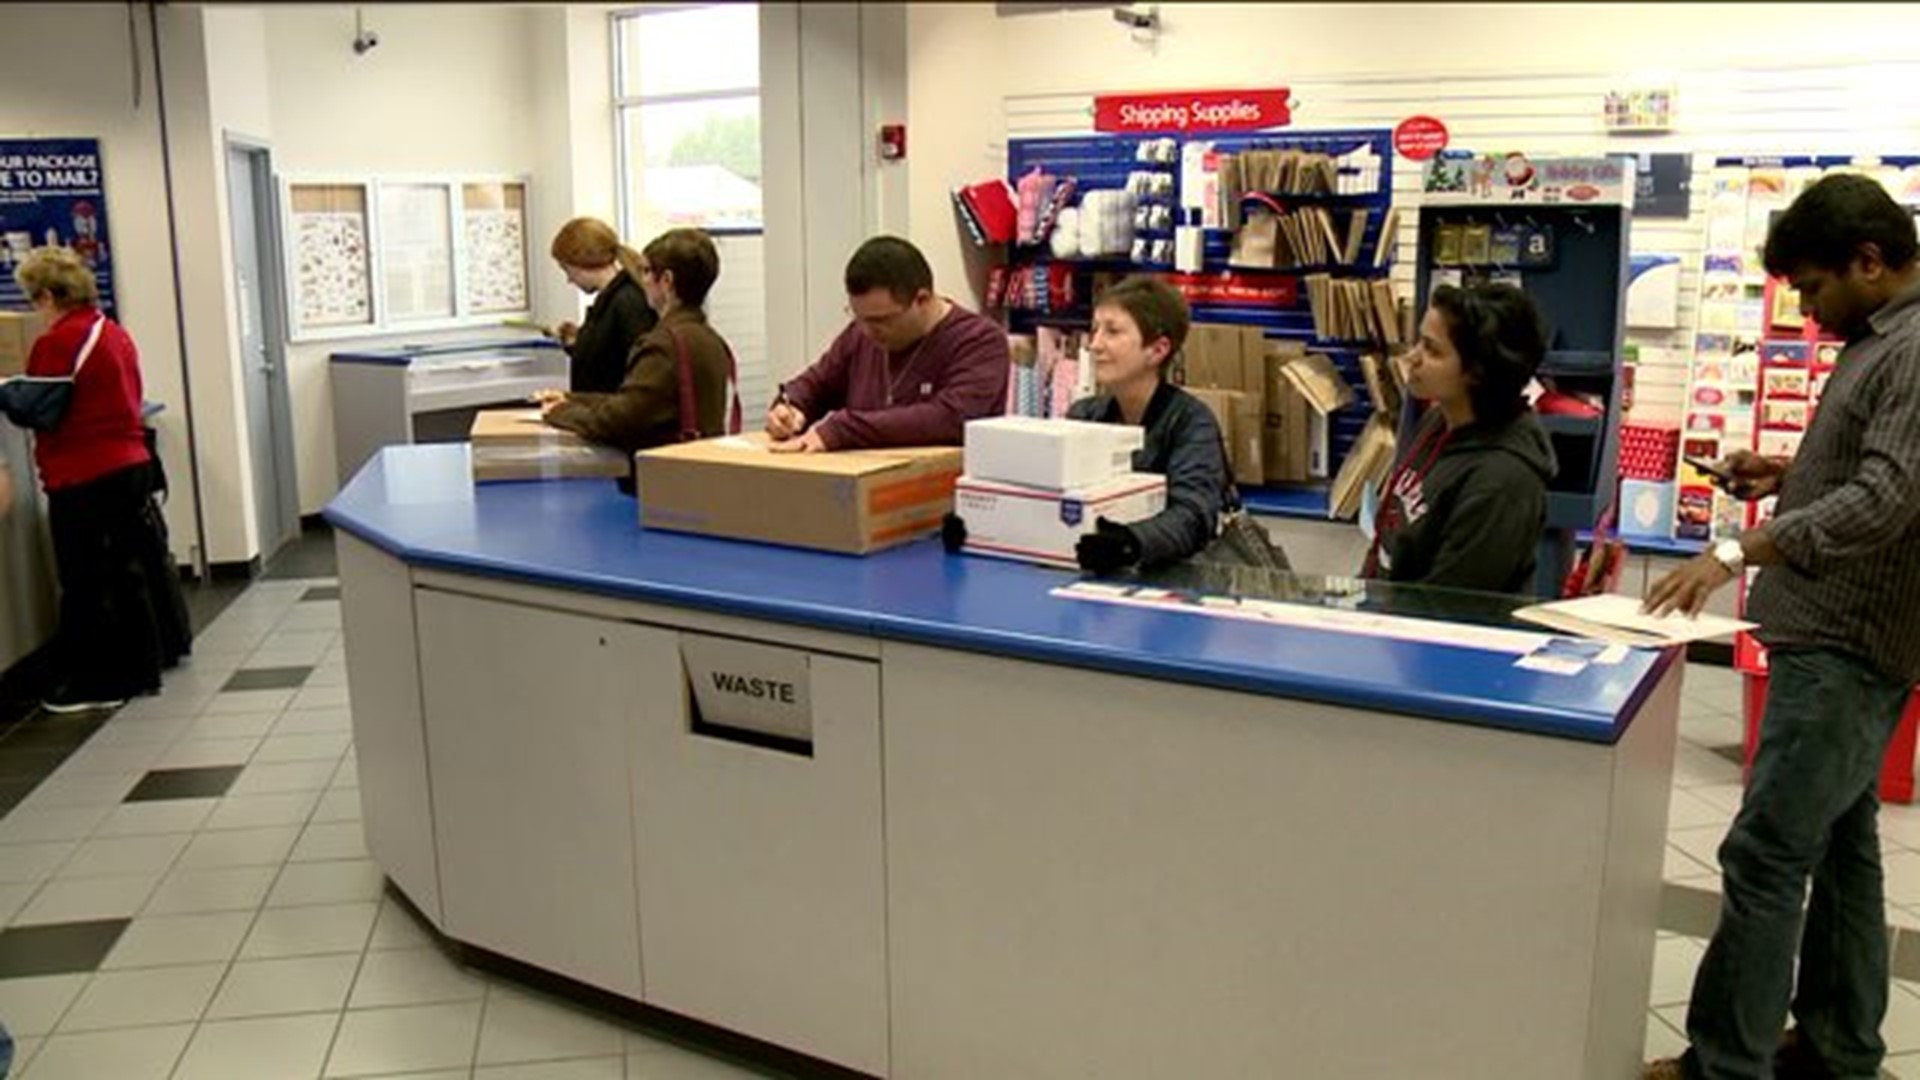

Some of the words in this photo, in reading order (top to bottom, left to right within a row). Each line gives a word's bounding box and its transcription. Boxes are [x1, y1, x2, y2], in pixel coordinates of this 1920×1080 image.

[1119, 103, 1188, 129] Shipping
[1191, 100, 1261, 126] Supplies
[26, 155, 95, 169] PACKAGE
[16, 171, 43, 187] TO
[45, 170, 98, 187] MAIL?
[1529, 234, 1545, 253] a
[711, 671, 796, 704] WASTE
